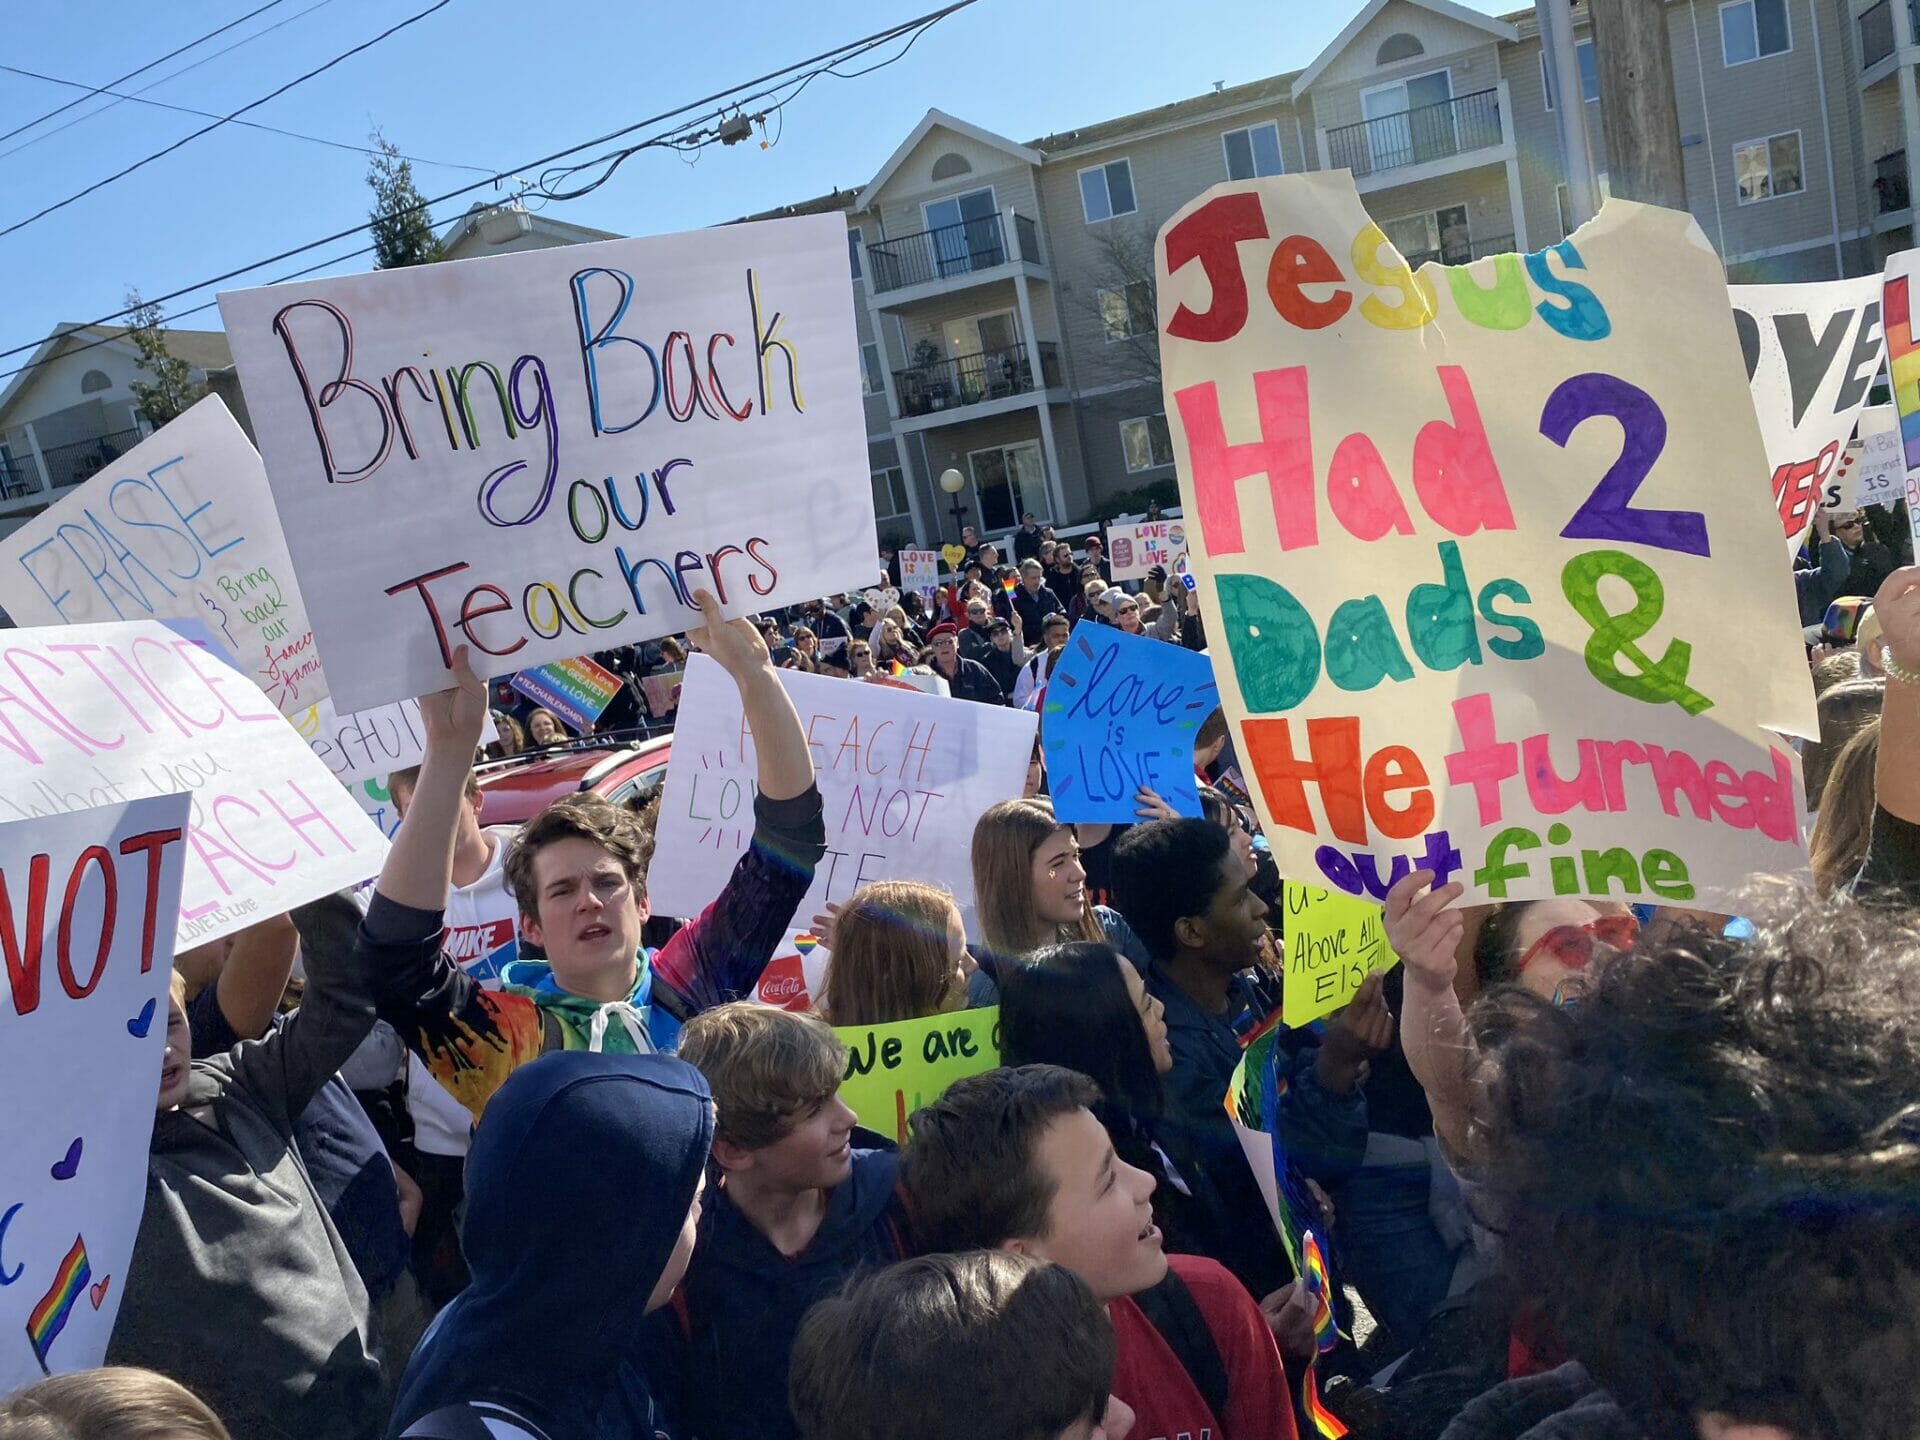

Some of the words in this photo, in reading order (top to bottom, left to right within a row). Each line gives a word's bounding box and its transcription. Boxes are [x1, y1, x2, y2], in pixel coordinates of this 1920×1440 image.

[1165, 191, 1611, 342] Jesus
[273, 299, 559, 527] Bring
[570, 268, 804, 437] Back
[1174, 365, 1517, 558] Had
[1539, 372, 1711, 557] 2
[568, 458, 694, 544] our
[20, 456, 245, 624] ERASE
[901, 552, 934, 562] LOVE
[1135, 524, 1167, 539] LOVE
[1139, 550, 1168, 566] LOVE
[1145, 540, 1157, 551] IS
[217, 567, 281, 602] Bring
[904, 563, 916, 574] IS
[240, 593, 288, 624] back
[262, 618, 289, 641] our
[384, 537, 777, 670] Teachers
[1214, 540, 1546, 713] Dads
[1561, 549, 1715, 716] &
[0, 635, 280, 765] ACTICE
[281, 655, 321, 700] fami
[567, 667, 609, 699] GREATEST
[1068, 642, 1185, 725] love
[739, 714, 937, 783] PEACH
[1107, 720, 1126, 746] is
[1078, 744, 1173, 803] LOVE
[1240, 716, 1435, 846] He
[1444, 693, 1798, 846] turned
[689, 773, 756, 821] LO
[841, 774, 945, 842] NOT
[825, 850, 887, 902] TE
[1315, 831, 1463, 901] out
[1473, 822, 1696, 900] fine
[0, 826, 183, 1016] NOT
[178, 914, 214, 942] LOVE
[442, 926, 497, 958] NIKE
[1293, 929, 1350, 974] Above
[842, 1031, 902, 1081] We
[923, 1026, 978, 1064] are
